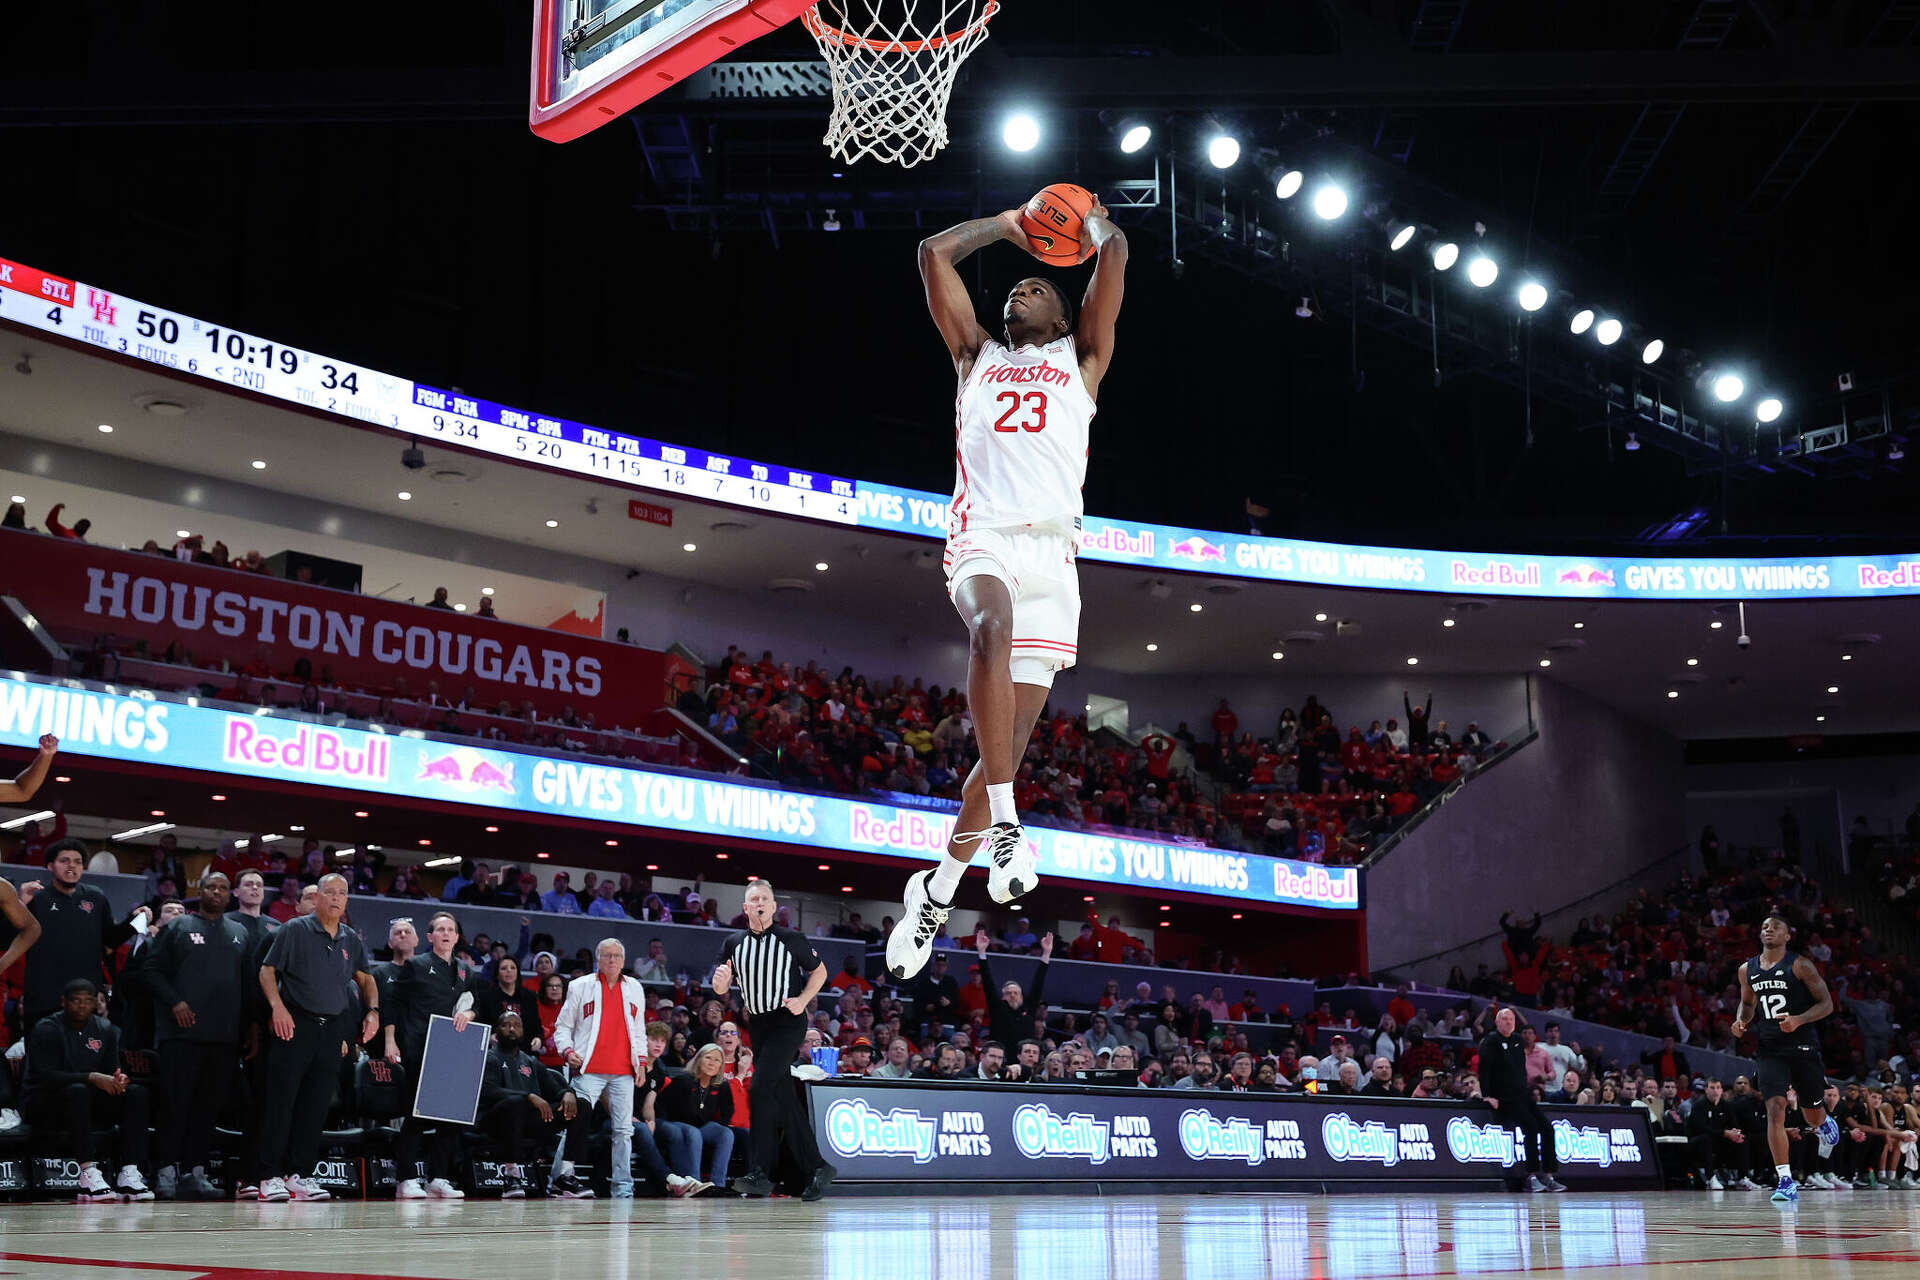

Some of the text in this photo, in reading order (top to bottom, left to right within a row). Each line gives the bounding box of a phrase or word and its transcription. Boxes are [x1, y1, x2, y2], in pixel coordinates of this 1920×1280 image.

[41, 277, 71, 302] STL
[47, 307, 62, 325] 4
[136, 311, 178, 344] 50
[118, 337, 128, 352] 3
[205, 328, 298, 375] 10:19
[188, 358, 198, 373] 6
[978, 360, 1070, 387] Houston
[232, 366, 265, 390] 2ND
[320, 365, 358, 395] 34
[327, 397, 337, 410] 2
[994, 391, 1047, 432] 23
[391, 413, 399, 428] 3
[706, 456, 731, 473] AST
[751, 464, 768, 481] TO
[663, 468, 685, 486] 18
[714, 478, 723, 492] 7
[831, 480, 853, 497] STL
[748, 485, 770, 502] 10
[798, 494, 806, 508] 1
[837, 502, 848, 515] 4
[856, 490, 950, 530] IVES YOU
[1082, 526, 1153, 555] ed Bull
[1235, 543, 1292, 573] GIVES
[1297, 549, 1341, 577] YOU
[1453, 562, 1539, 586] Red Bull
[1625, 566, 1685, 591] GIVES
[1689, 566, 1737, 590] YOU
[1860, 565, 1906, 585] Red
[84, 567, 602, 697] HOUSTON COUGARS
[227, 719, 386, 778] Red Bull
[532, 760, 623, 812] GIVES
[631, 773, 695, 821] YOU
[853, 807, 903, 844] Red
[1053, 835, 1117, 875] GIVES
[1120, 842, 1165, 881] YOU
[1276, 866, 1313, 897] Red
[1751, 979, 1789, 993] BUTLER
[1760, 994, 1790, 1020] 12
[829, 1101, 935, 1162] O'Reilly
[942, 1111, 985, 1134] AUTO
[1015, 1106, 1108, 1162] O'Reilly
[1113, 1115, 1151, 1137] AUTO
[1266, 1120, 1300, 1140] AUTO
[1399, 1123, 1429, 1141] AUTO
[937, 1134, 992, 1157] PARTS
[1110, 1136, 1158, 1158] PARTS
[1181, 1110, 1262, 1163] O'Reilly
[1324, 1115, 1396, 1164] O'Reilly
[1449, 1118, 1513, 1165] O'Reilly
[1610, 1128, 1635, 1145] AUTO
[1264, 1139, 1307, 1160] PARTS
[1399, 1141, 1436, 1161] PARTS
[1610, 1145, 1642, 1162] PARTS
[312, 1161, 347, 1177] JOINT
[45, 1178, 81, 1188] chiropr
